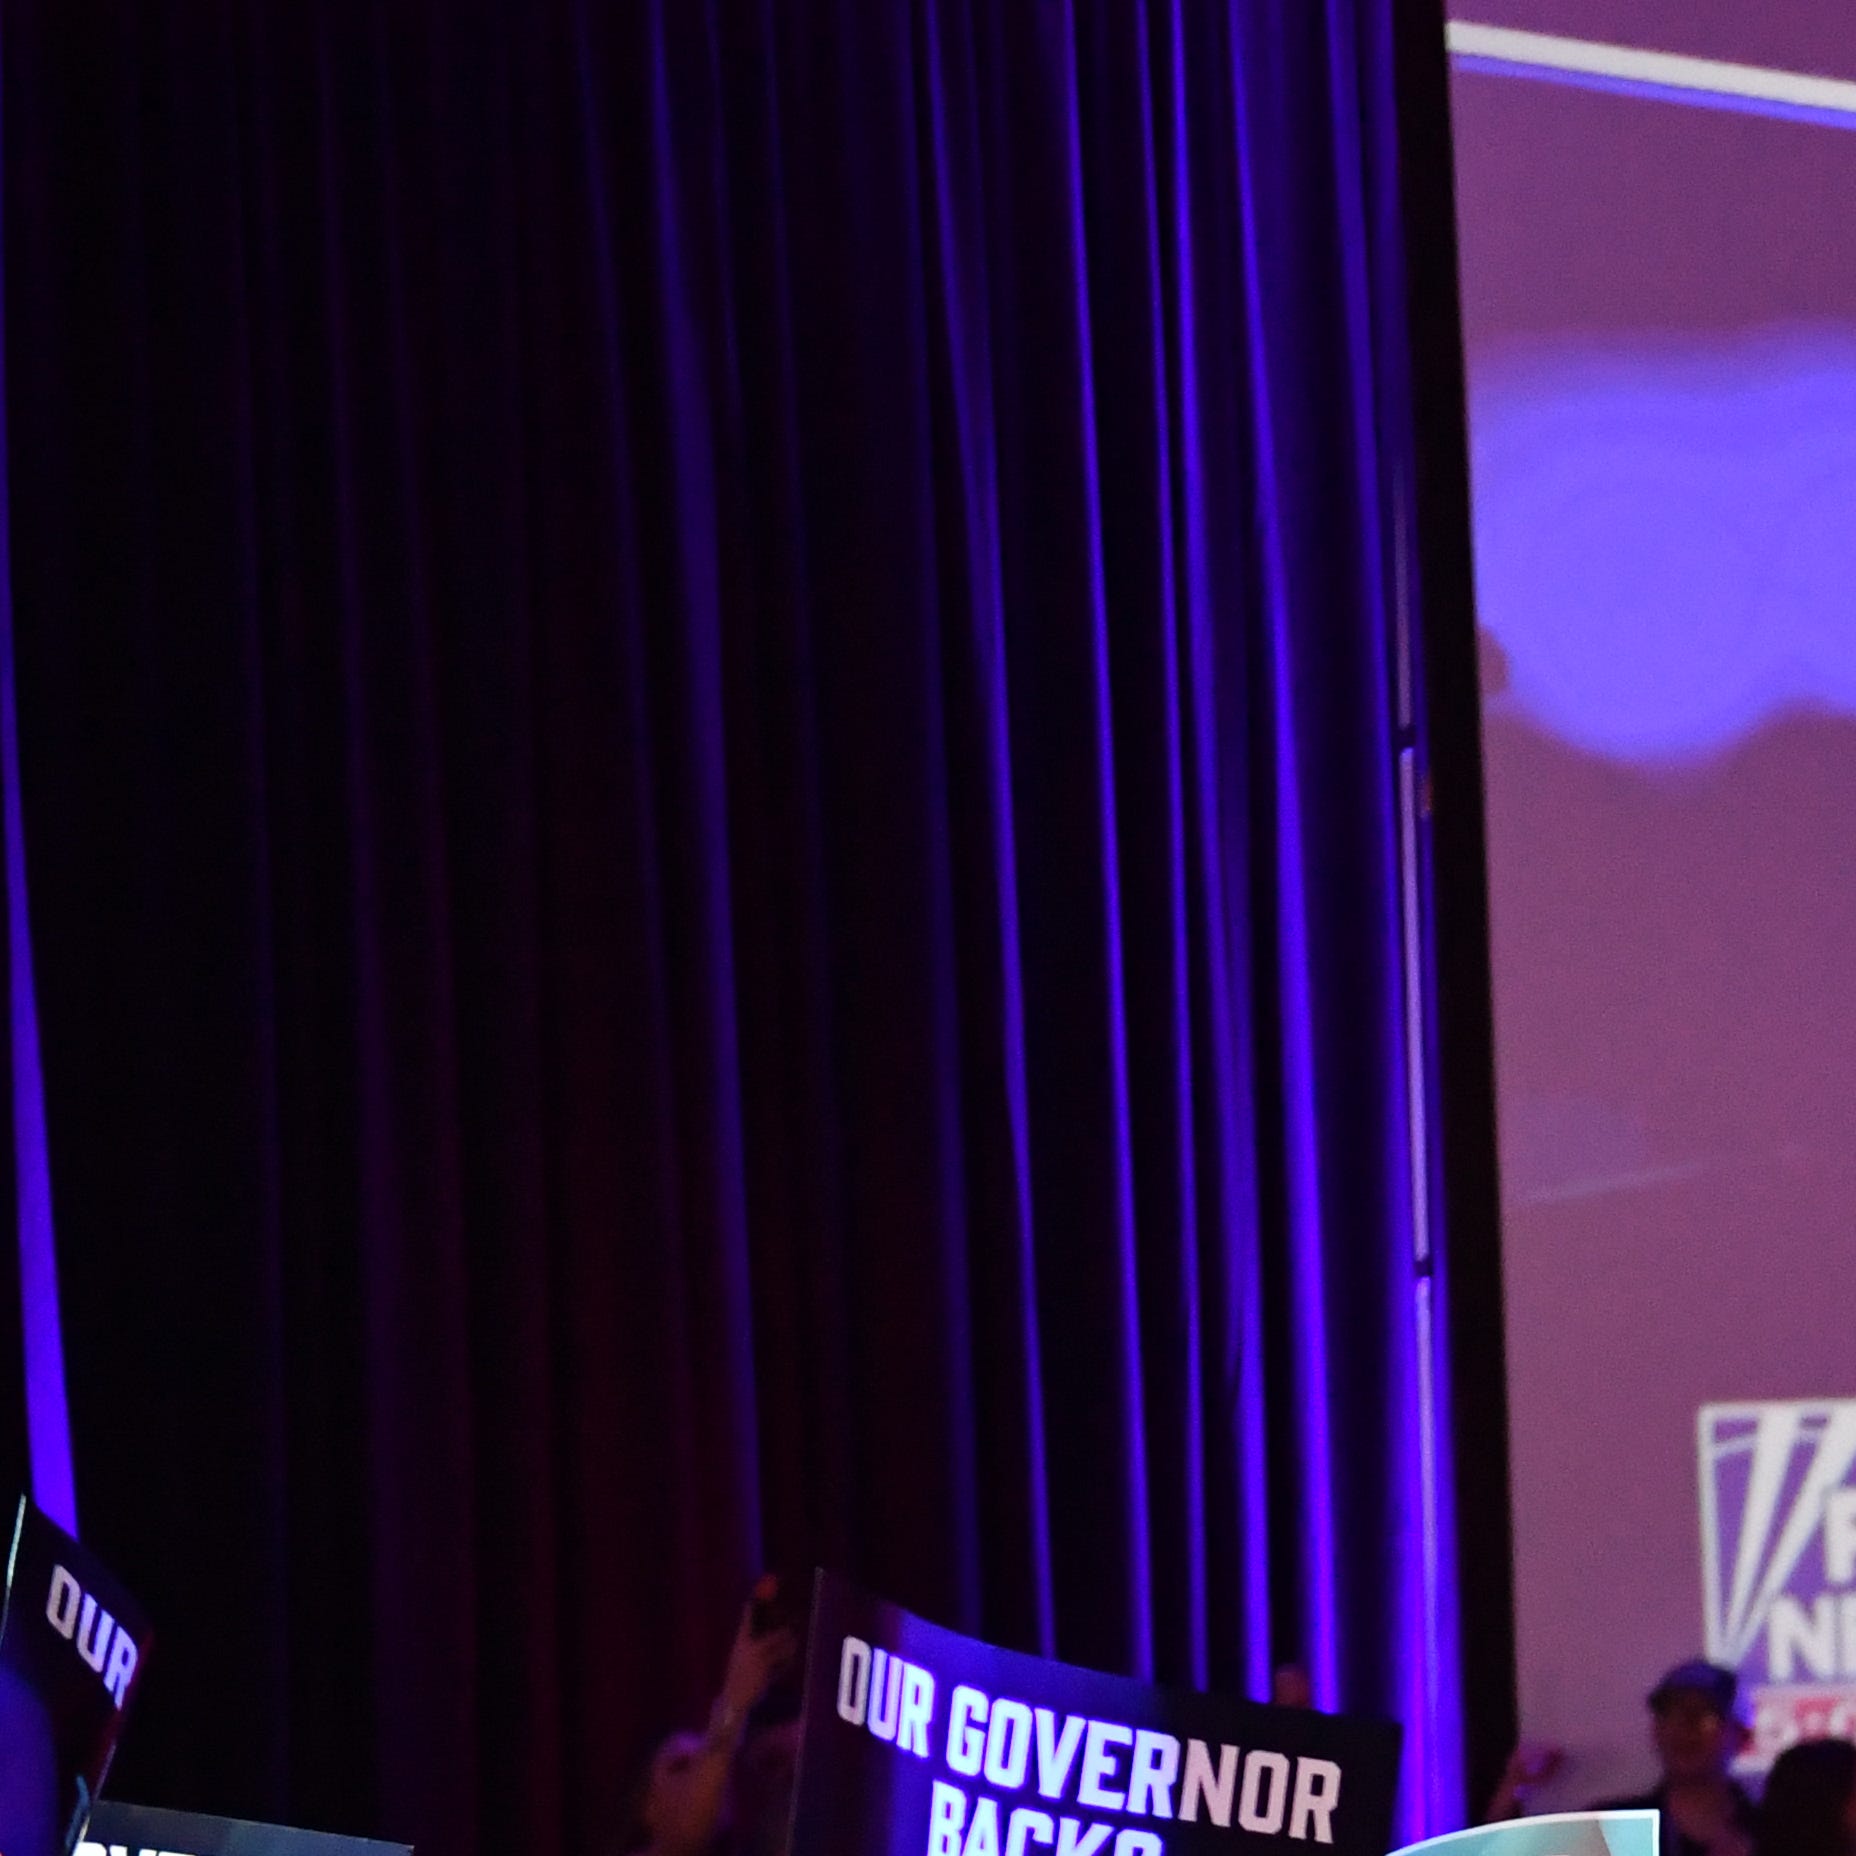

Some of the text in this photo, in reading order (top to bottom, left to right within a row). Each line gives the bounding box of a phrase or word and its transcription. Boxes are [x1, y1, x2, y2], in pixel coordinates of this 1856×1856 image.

[47, 1564, 138, 1711] OUR
[836, 1636, 1342, 1844] OUR GOVERNOR
